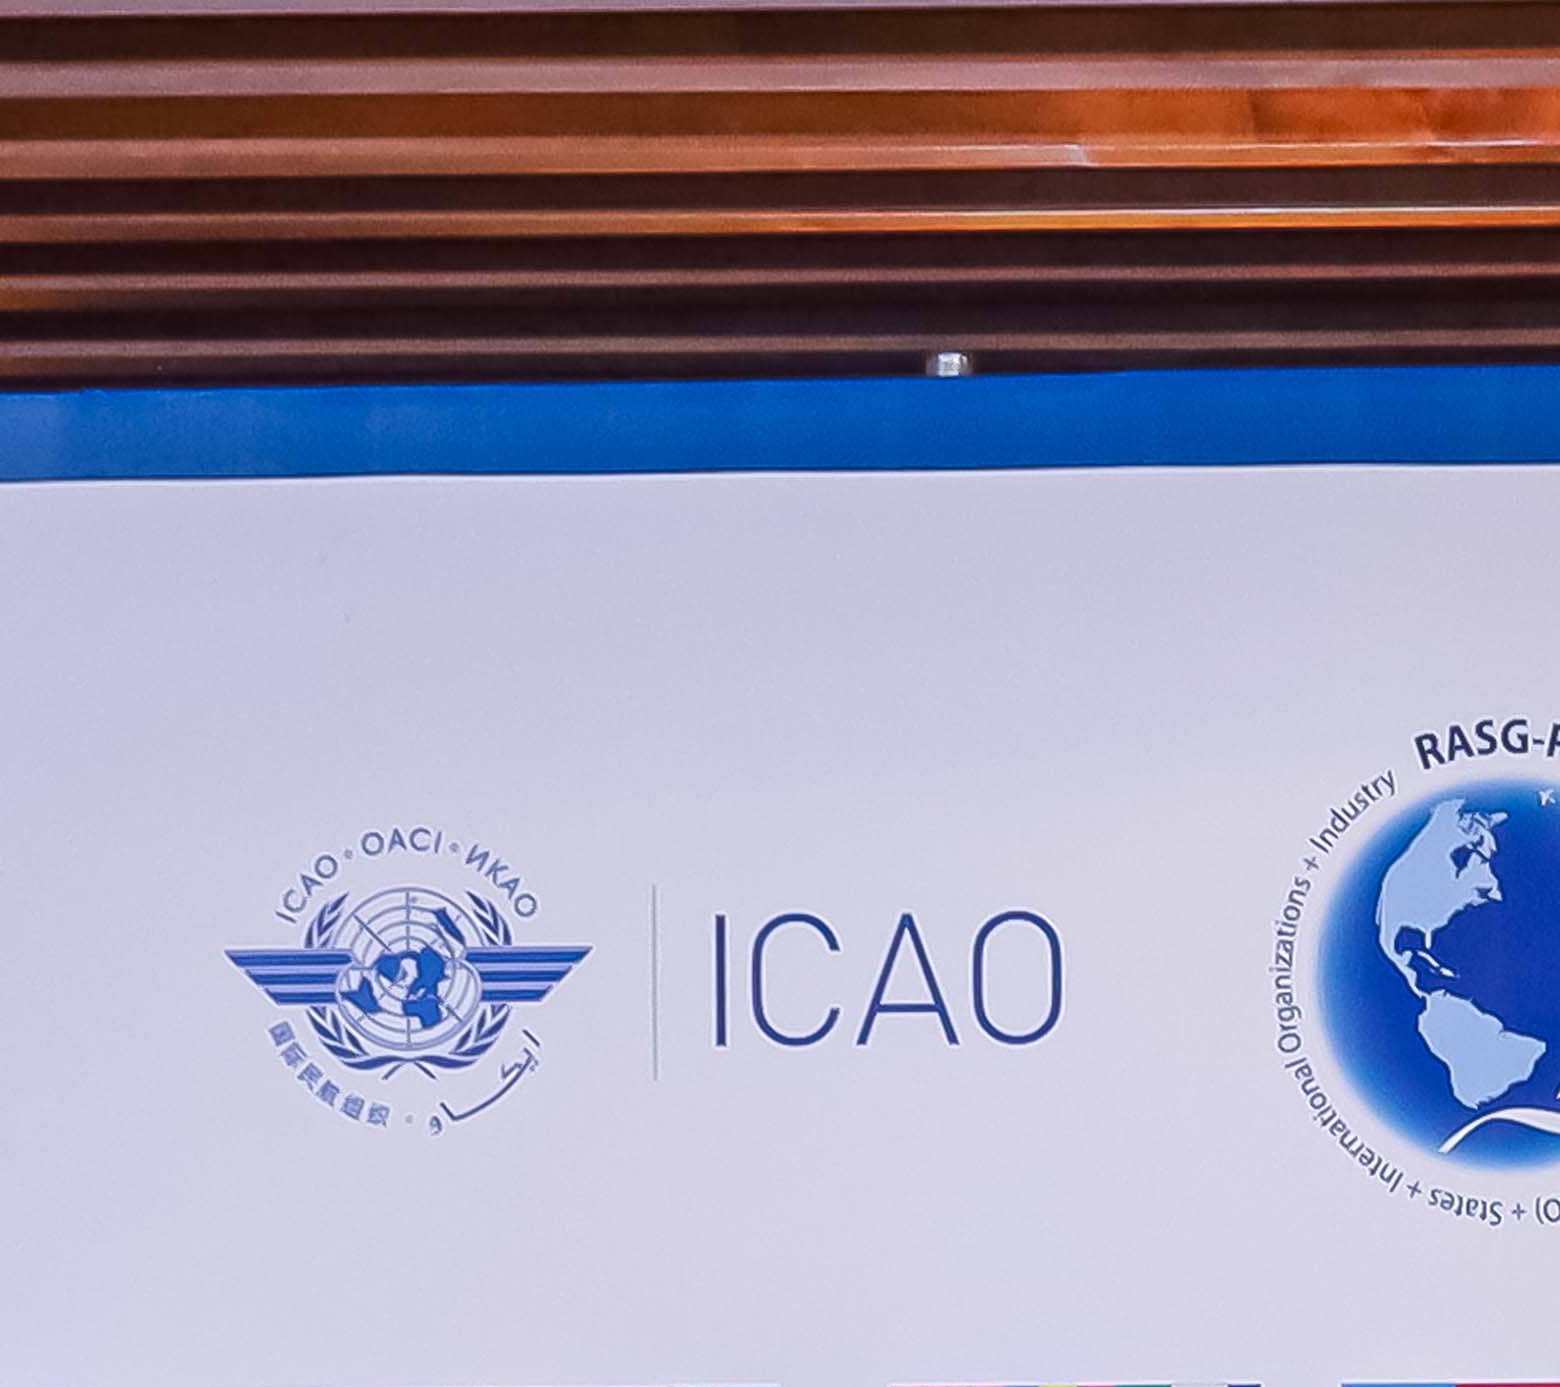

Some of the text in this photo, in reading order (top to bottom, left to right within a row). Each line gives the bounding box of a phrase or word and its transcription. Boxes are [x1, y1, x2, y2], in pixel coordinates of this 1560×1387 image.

[360, 826, 443, 856] OACI
[1316, 769, 1397, 855] Industry
[275, 854, 339, 924] ICAO
[714, 910, 1066, 1048] ICAO
[1269, 876, 1312, 1055] Organizations
[1285, 1058, 1402, 1193] International
[1430, 1187, 1503, 1226] States
